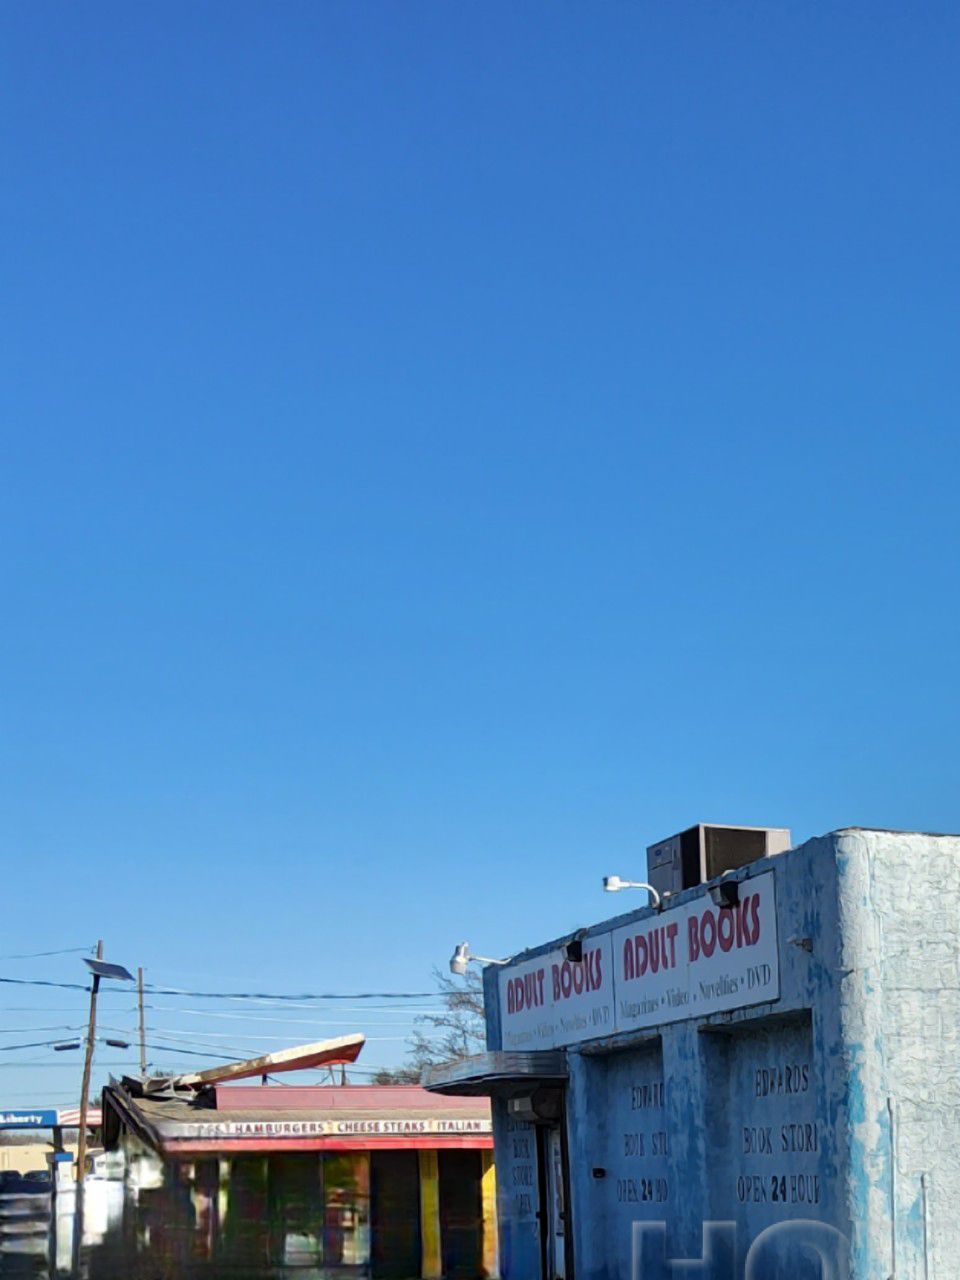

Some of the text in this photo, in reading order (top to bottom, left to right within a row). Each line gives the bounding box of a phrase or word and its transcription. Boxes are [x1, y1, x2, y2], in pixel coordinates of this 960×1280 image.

[622, 893, 760, 981] ADULT BOOKS
[507, 948, 602, 1015] ADULT BOOKS
[699, 972, 739, 1000] Novelties
[747, 963, 771, 990] DVD
[755, 1063, 809, 1097] EDWARDS
[235, 1123, 325, 1134] HAMBURGERS
[337, 1121, 380, 1133] CHEESE
[383, 1121, 425, 1132] STEAKS
[437, 1121, 481, 1131] ITALIAN
[743, 1127, 773, 1155] BOOK
[641, 1178, 653, 1201] 24
[737, 1175, 768, 1203] OPEN
[770, 1175, 788, 1202] 24
